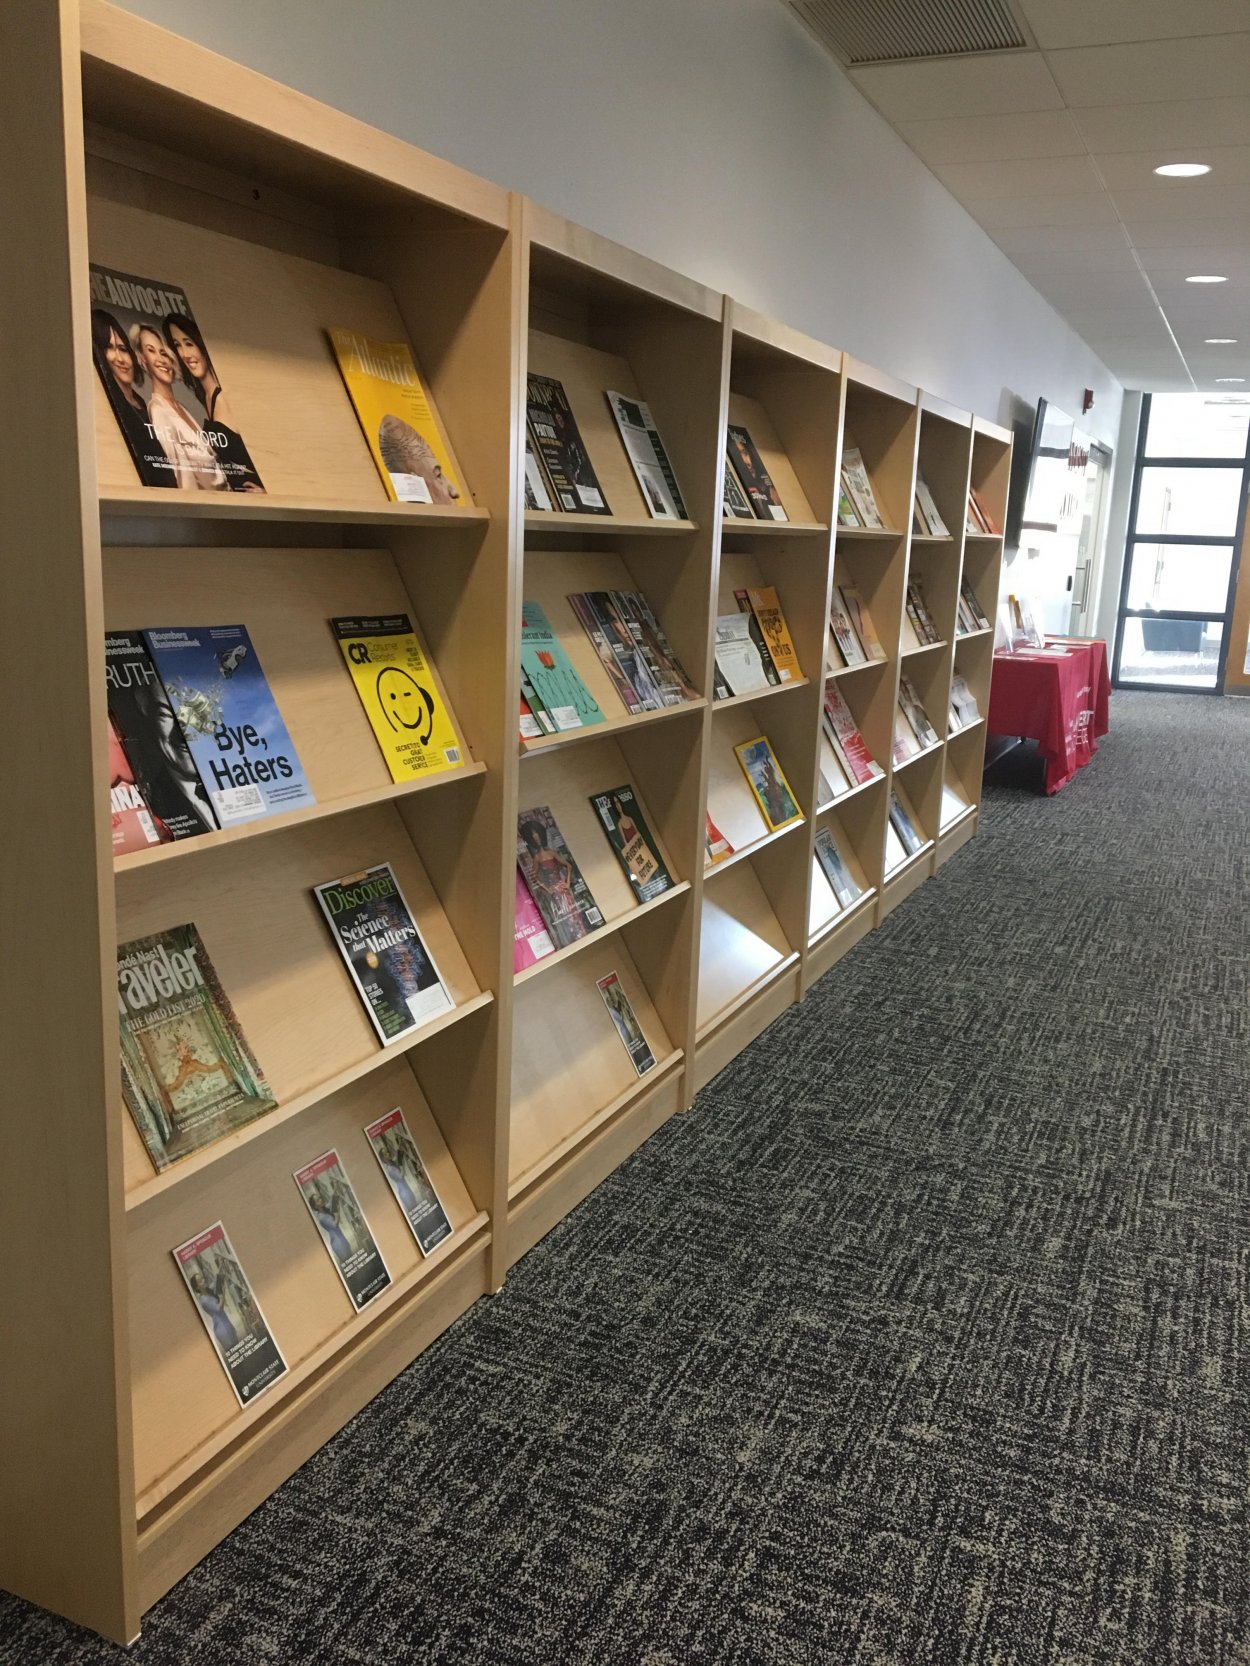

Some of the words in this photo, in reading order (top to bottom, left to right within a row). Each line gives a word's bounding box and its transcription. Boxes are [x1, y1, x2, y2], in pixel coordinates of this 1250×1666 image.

[105, 276, 187, 317] ADVOCATE
[144, 423, 174, 442] THE
[148, 631, 188, 641] Bloomberg
[151, 638, 201, 648] Businessweek
[348, 642, 372, 664] CR
[106, 661, 160, 688] RUTH
[212, 721, 268, 755] Bye,
[208, 756, 293, 790] Haters
[324, 876, 396, 915] Discover
[340, 915, 390, 944] Science
[356, 912, 369, 922] The
[365, 925, 416, 954] Matters
[117, 954, 136, 970] ondé
[136, 947, 160, 963] Nast
[118, 944, 204, 1014] aveler
[228, 1352, 240, 1363] NEED
[245, 1338, 257, 1349] KNOW
[230, 1340, 244, 1353] THINGS
[244, 1333, 253, 1342] YOU
[231, 1355, 244, 1369] ABOUT
[252, 1337, 268, 1351] LIBRARY
[248, 1368, 269, 1387] MONTCLAIR
[269, 1359, 280, 1370] STATE
